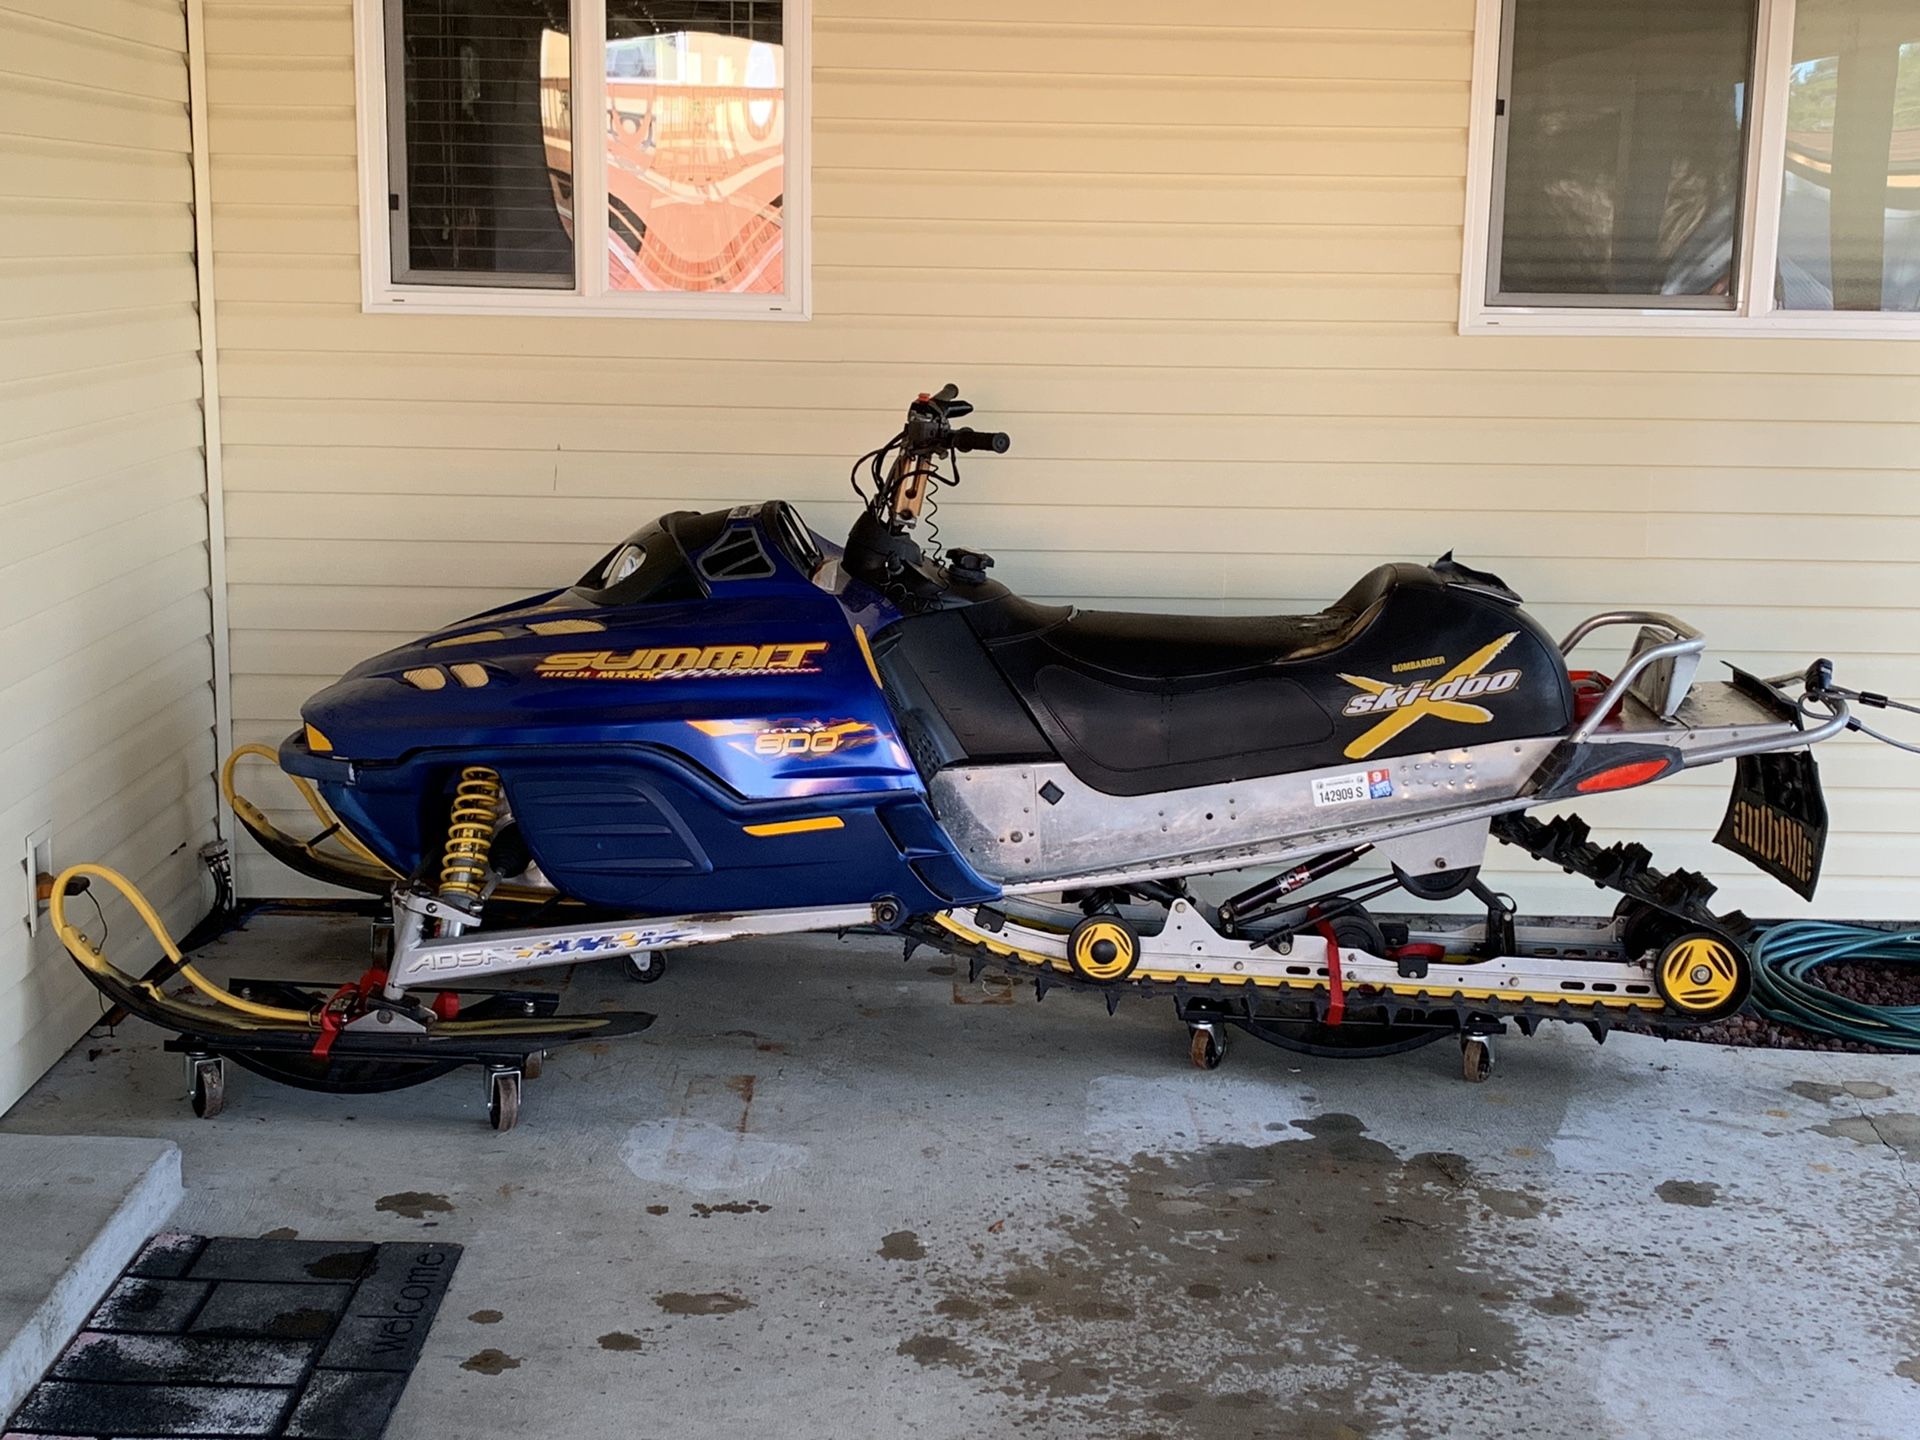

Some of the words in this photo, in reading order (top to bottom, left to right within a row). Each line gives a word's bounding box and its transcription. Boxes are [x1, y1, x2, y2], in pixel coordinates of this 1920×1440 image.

[534, 641, 829, 671] SUMMIT
[1391, 656, 1445, 673] BOMBARDIER
[541, 670, 592, 679] HIGH
[594, 669, 656, 680] MARK
[754, 732, 839, 755] 800
[1319, 787, 1354, 803] 142909
[1355, 786, 1364, 798] S
[356, 1252, 445, 1355] welcome
